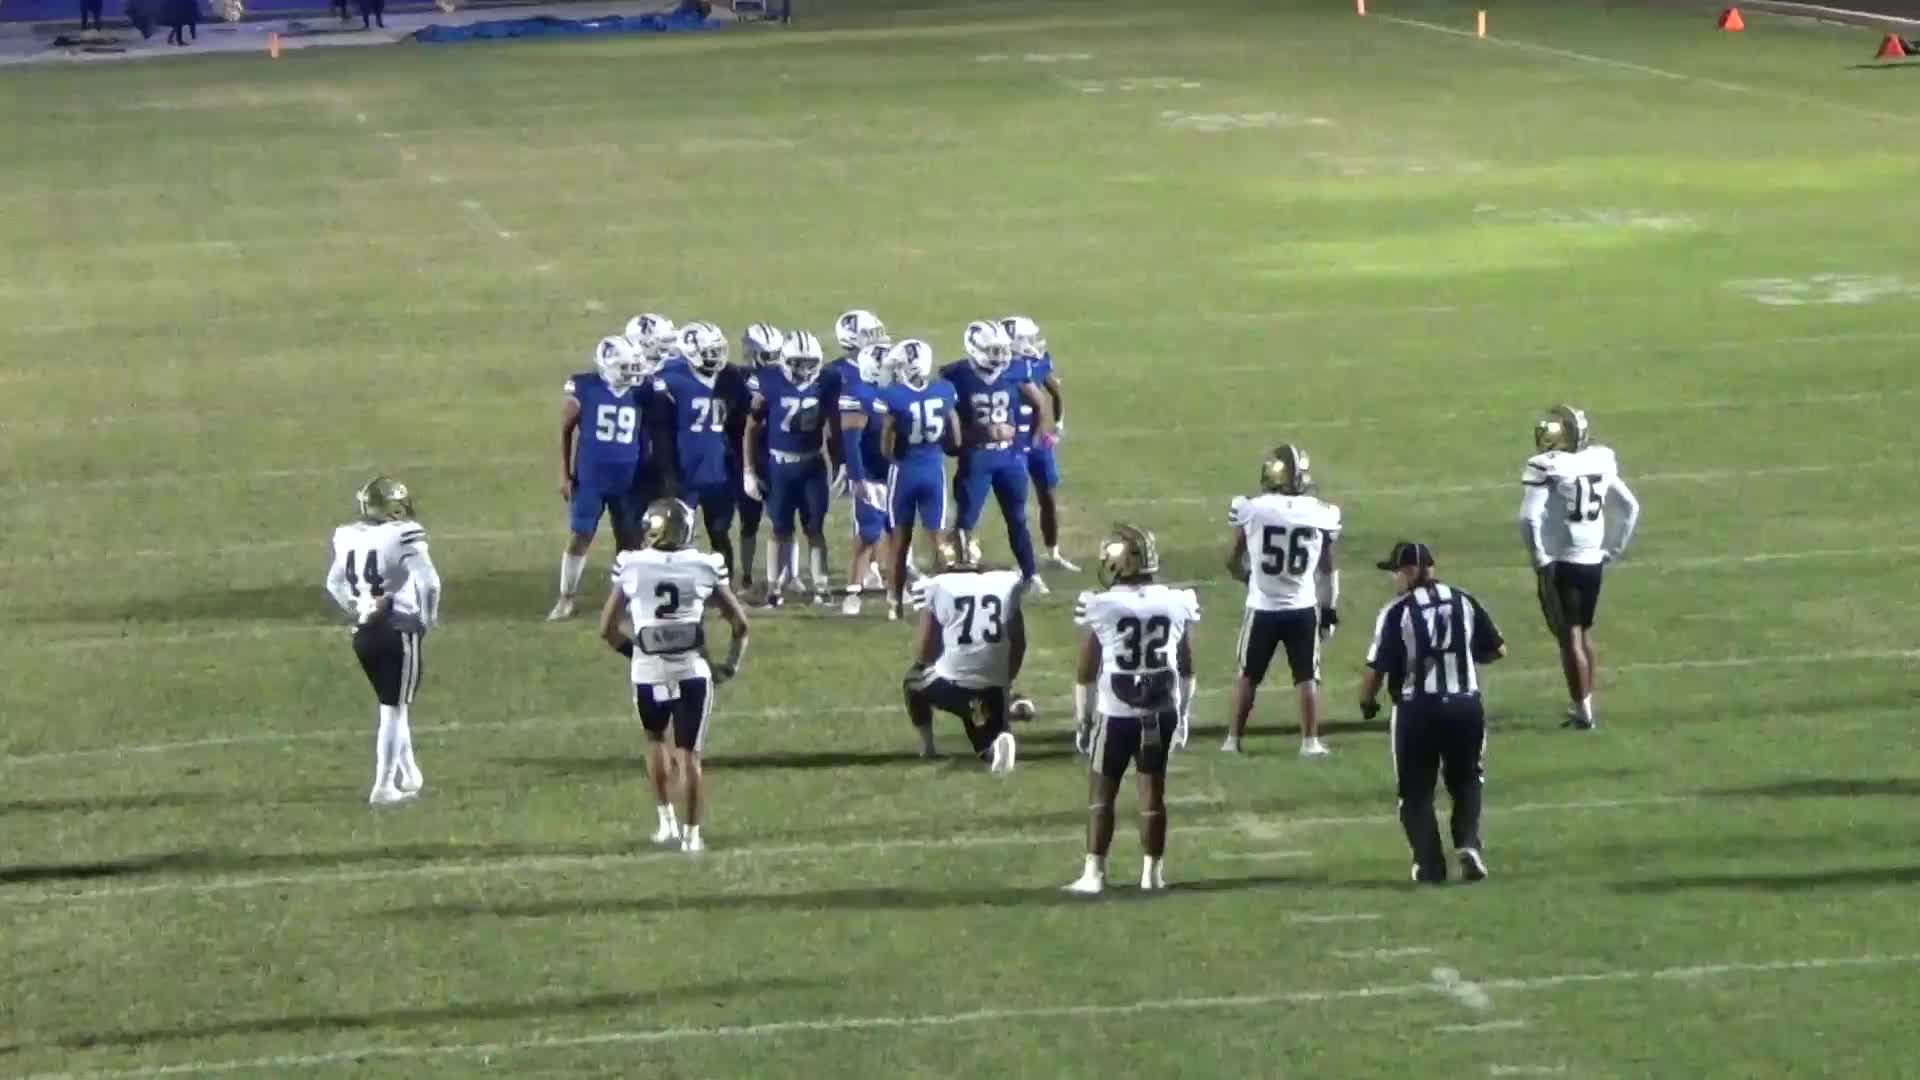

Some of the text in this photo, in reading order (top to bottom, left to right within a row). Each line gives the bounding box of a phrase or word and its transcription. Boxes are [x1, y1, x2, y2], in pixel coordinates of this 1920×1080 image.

[595, 403, 637, 445] 59
[908, 398, 945, 444] 15
[1566, 473, 1603, 523] 15
[345, 548, 385, 598] 44
[1261, 525, 1311, 577] 56
[654, 581, 680, 620] 2
[953, 593, 1002, 646] 73
[1114, 614, 1171, 671] 32
